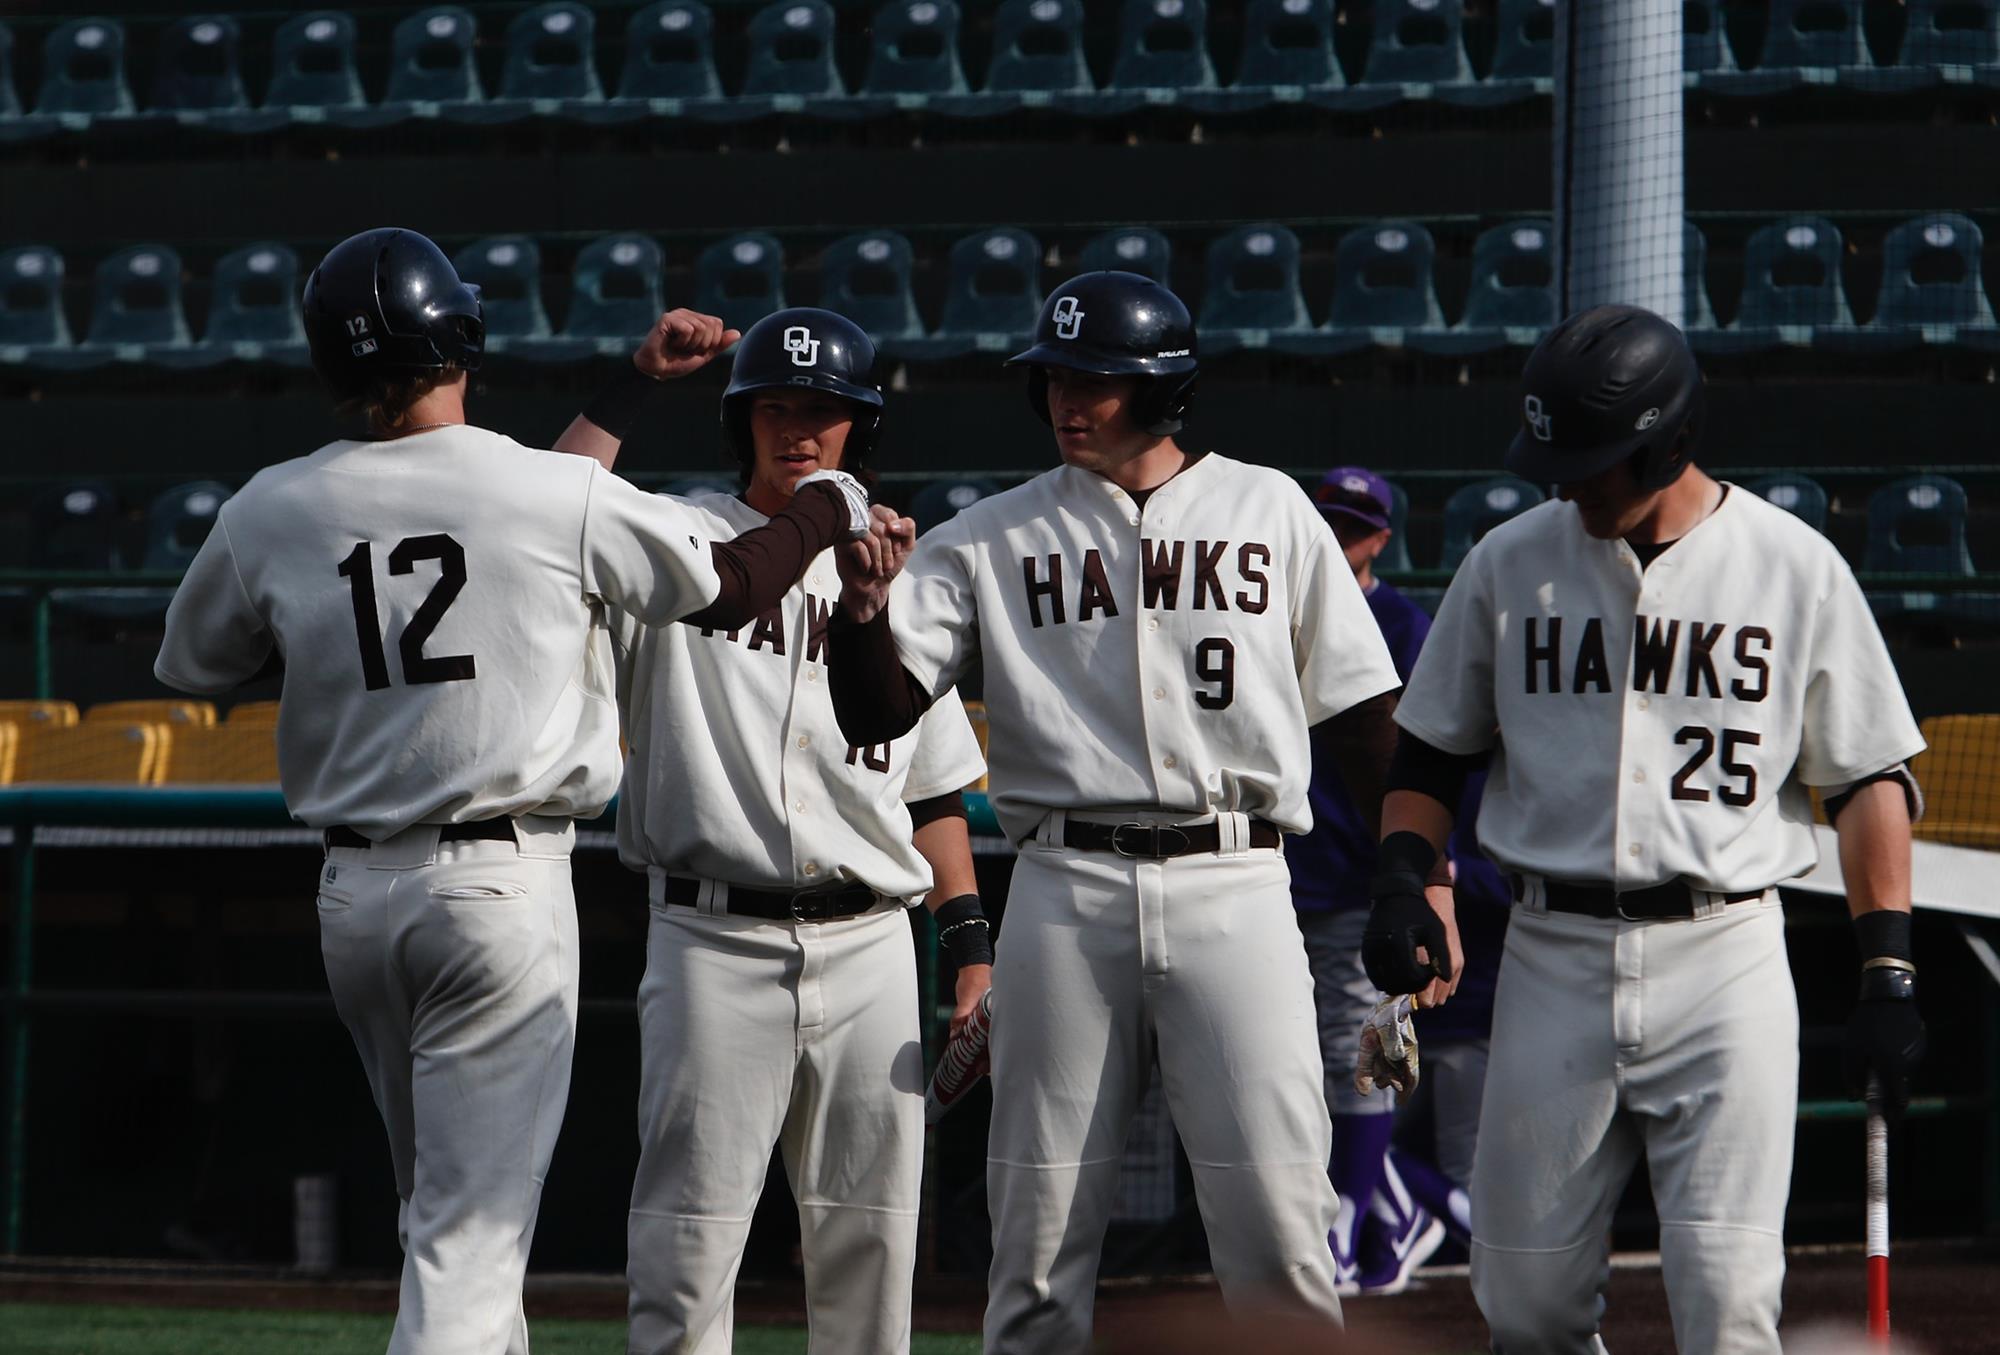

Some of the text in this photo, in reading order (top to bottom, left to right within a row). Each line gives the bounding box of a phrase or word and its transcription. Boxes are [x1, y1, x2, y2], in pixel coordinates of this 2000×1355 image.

[346, 316, 369, 336] 12
[338, 534, 476, 692] 12
[1023, 538, 1271, 629] HAWKS
[1195, 637, 1235, 711] 9
[1524, 614, 1771, 703] HAWKS
[1671, 725, 1760, 807] 25
